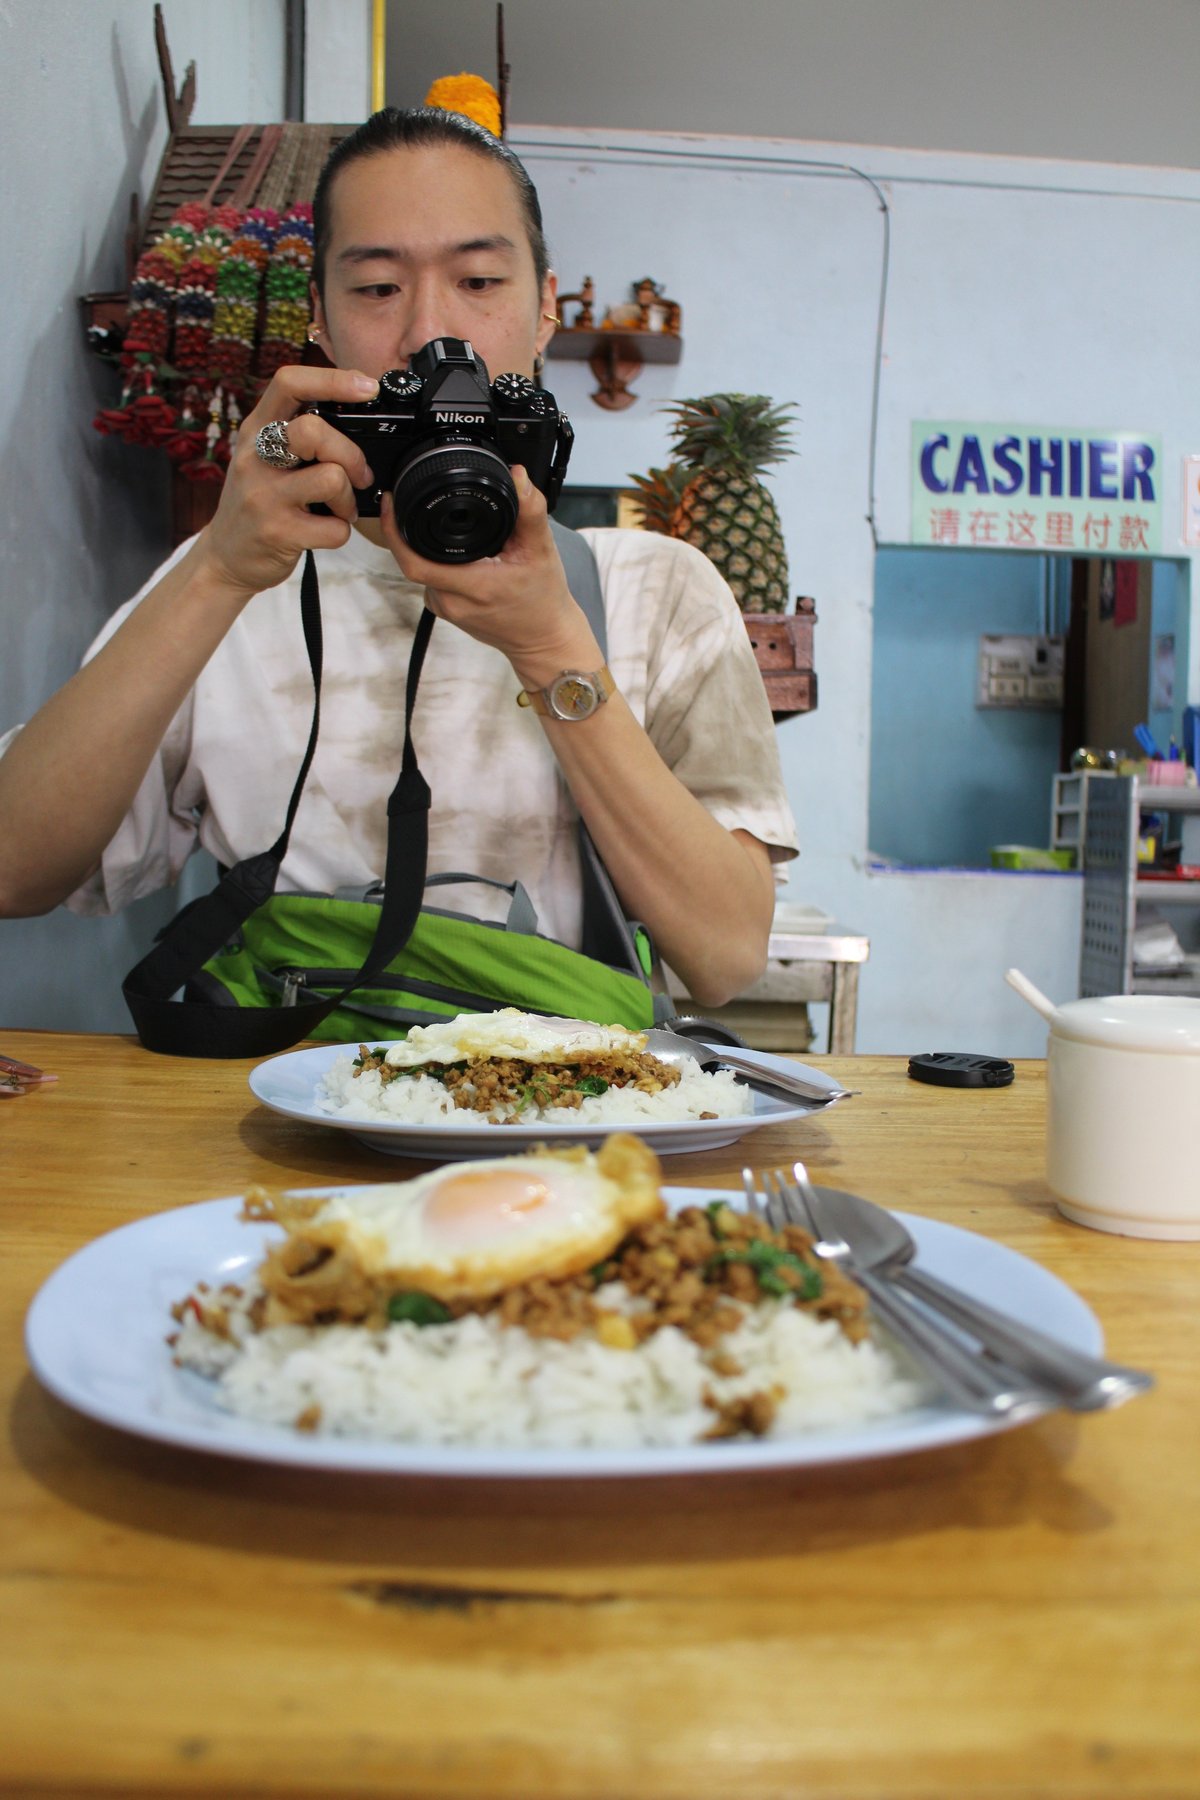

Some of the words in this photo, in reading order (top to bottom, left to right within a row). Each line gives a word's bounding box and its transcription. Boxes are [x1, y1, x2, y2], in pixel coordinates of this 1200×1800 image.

[435, 412, 485, 424] Nikon
[920, 433, 1156, 502] CASHIER
[929, 507, 1150, 551] 请在这里付款
